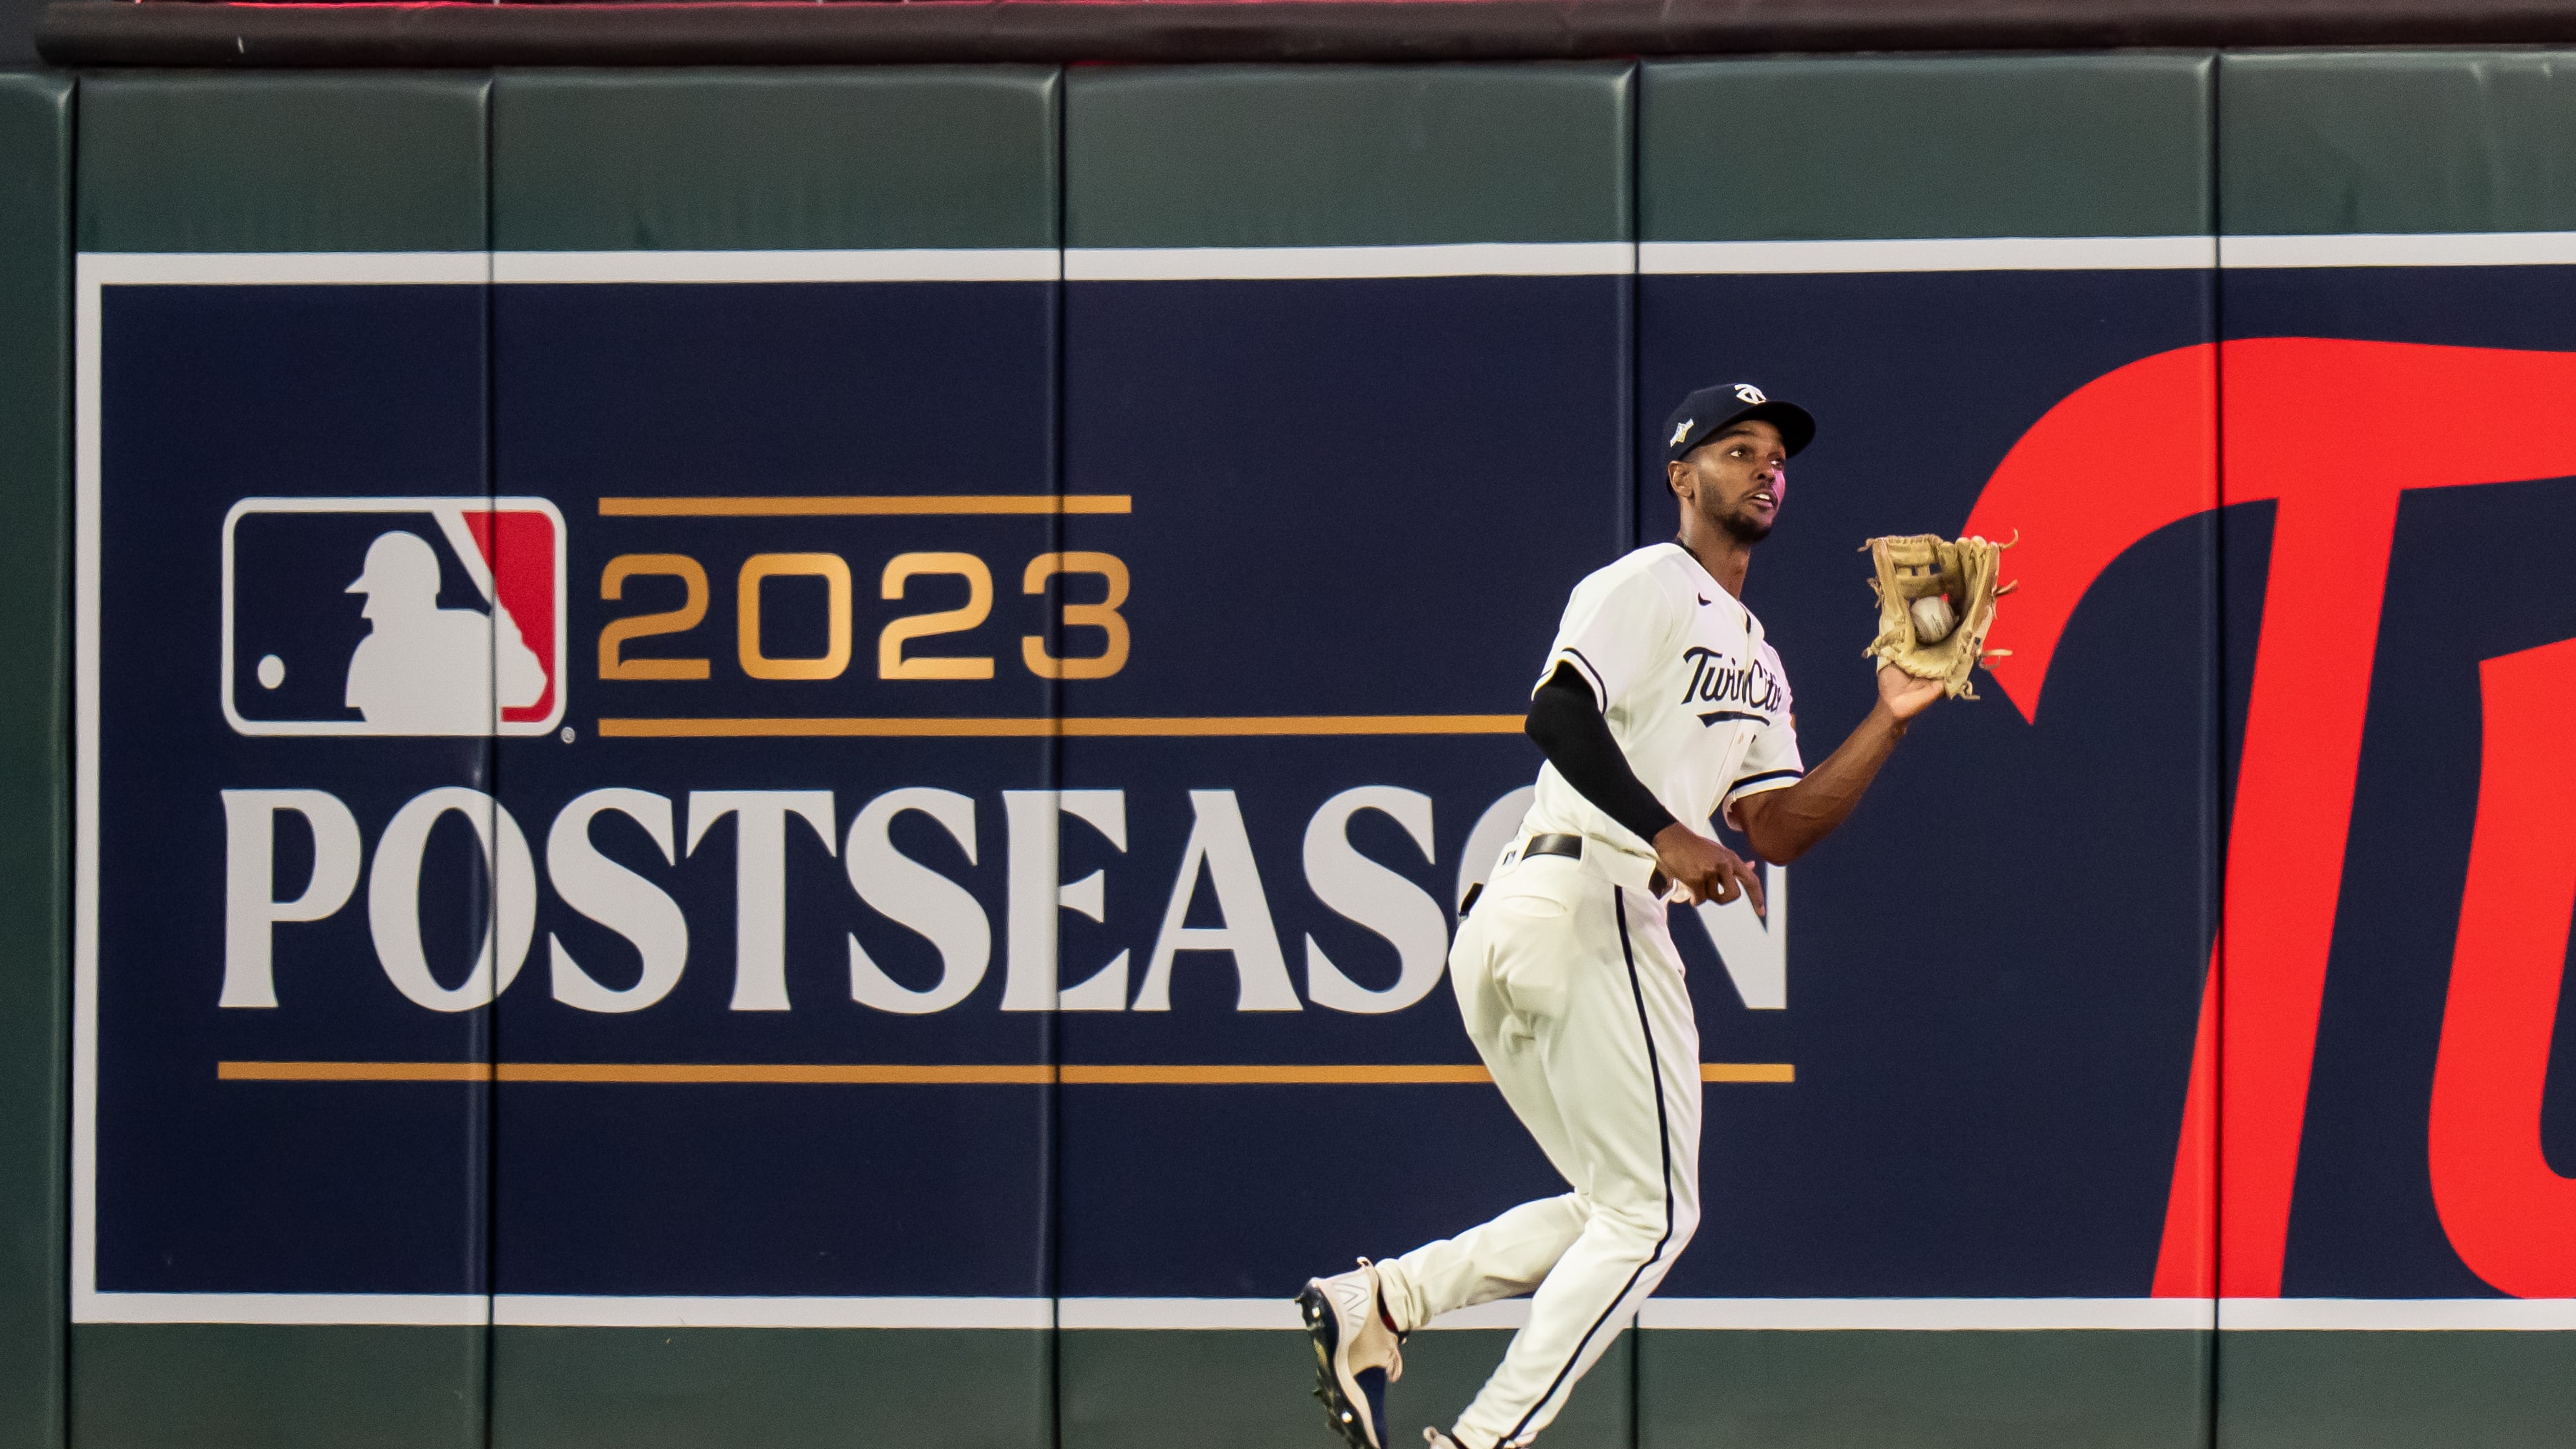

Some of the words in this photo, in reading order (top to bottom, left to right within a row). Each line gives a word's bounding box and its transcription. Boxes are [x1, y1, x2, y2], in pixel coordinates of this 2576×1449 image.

[598, 551, 1130, 681] 2023
[1681, 646, 1748, 705] Twin
[218, 785, 1787, 1014] POSTSEASN
